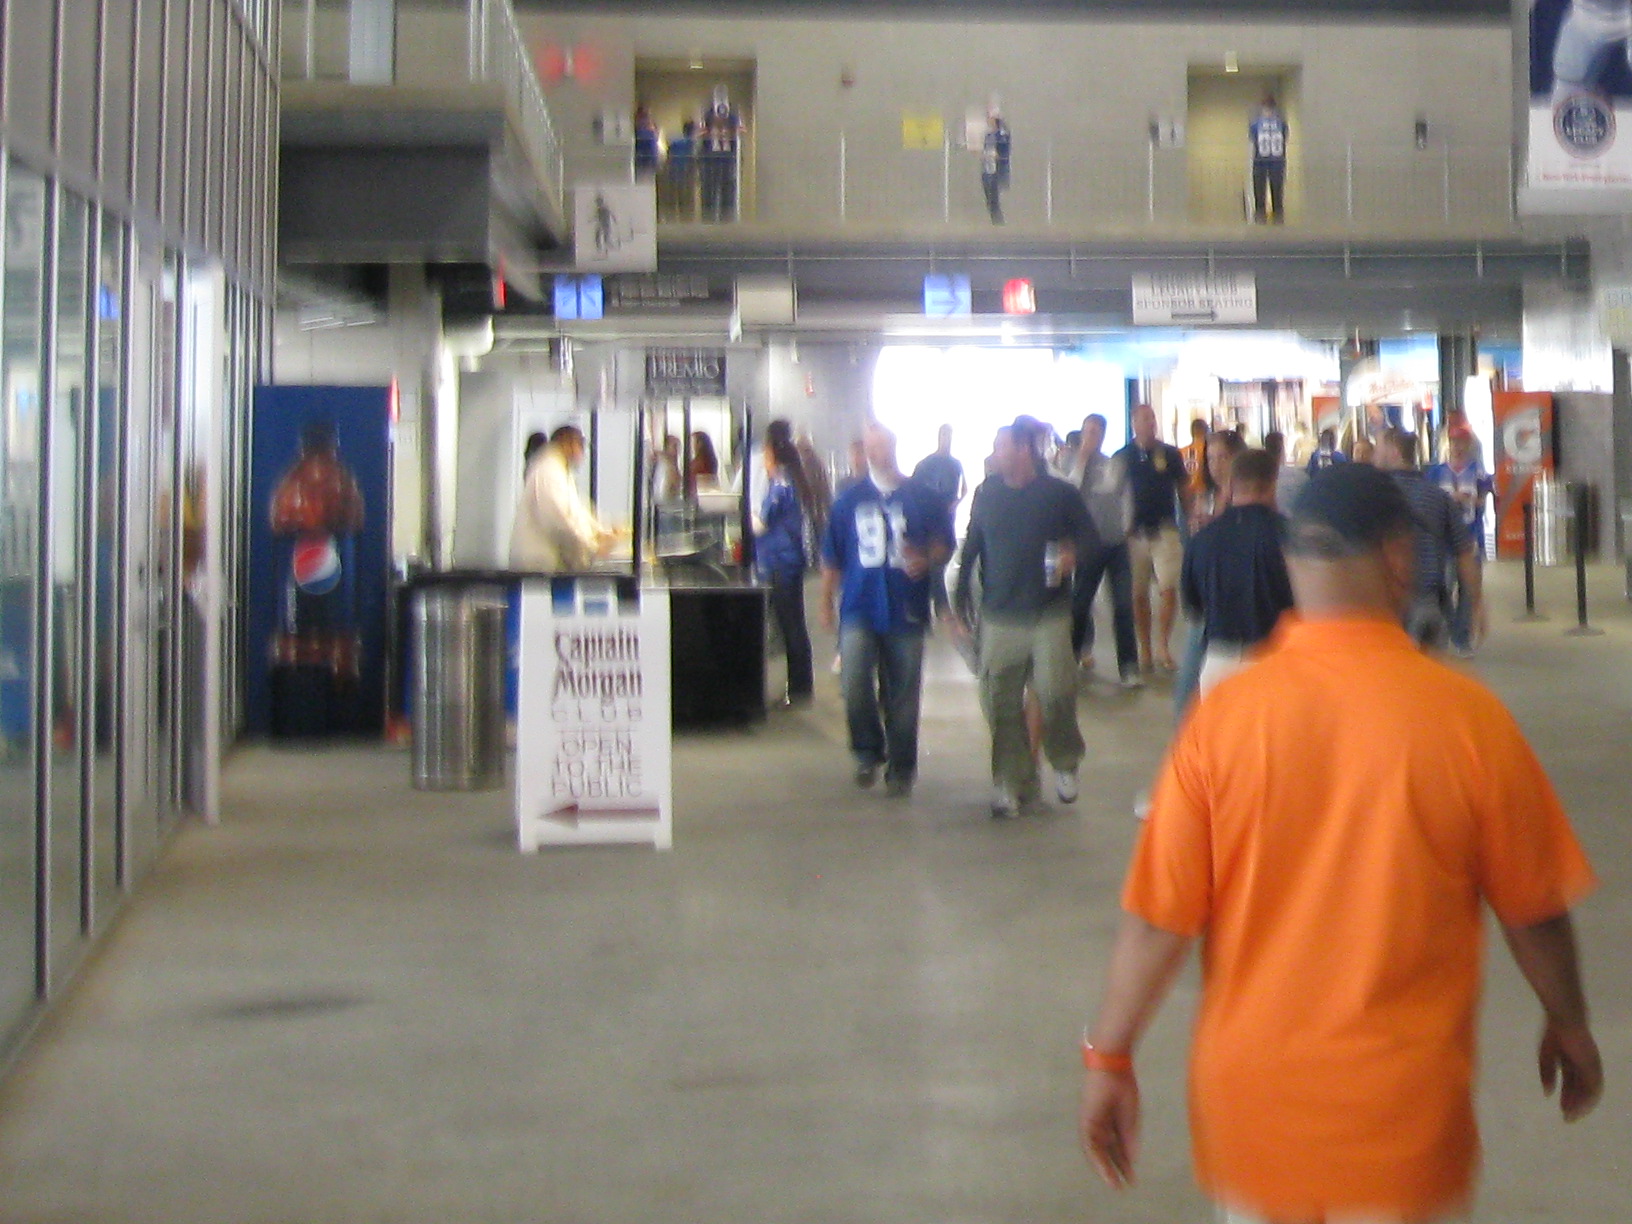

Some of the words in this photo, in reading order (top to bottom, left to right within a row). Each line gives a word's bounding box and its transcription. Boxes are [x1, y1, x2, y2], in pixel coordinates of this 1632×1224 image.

[554, 628, 641, 669] Captain
[553, 667, 642, 706] Morgan
[552, 704, 643, 722] CLUB
[562, 736, 633, 757] OPEN
[599, 755, 642, 775] THE
[552, 779, 642, 798] PUBLIC
